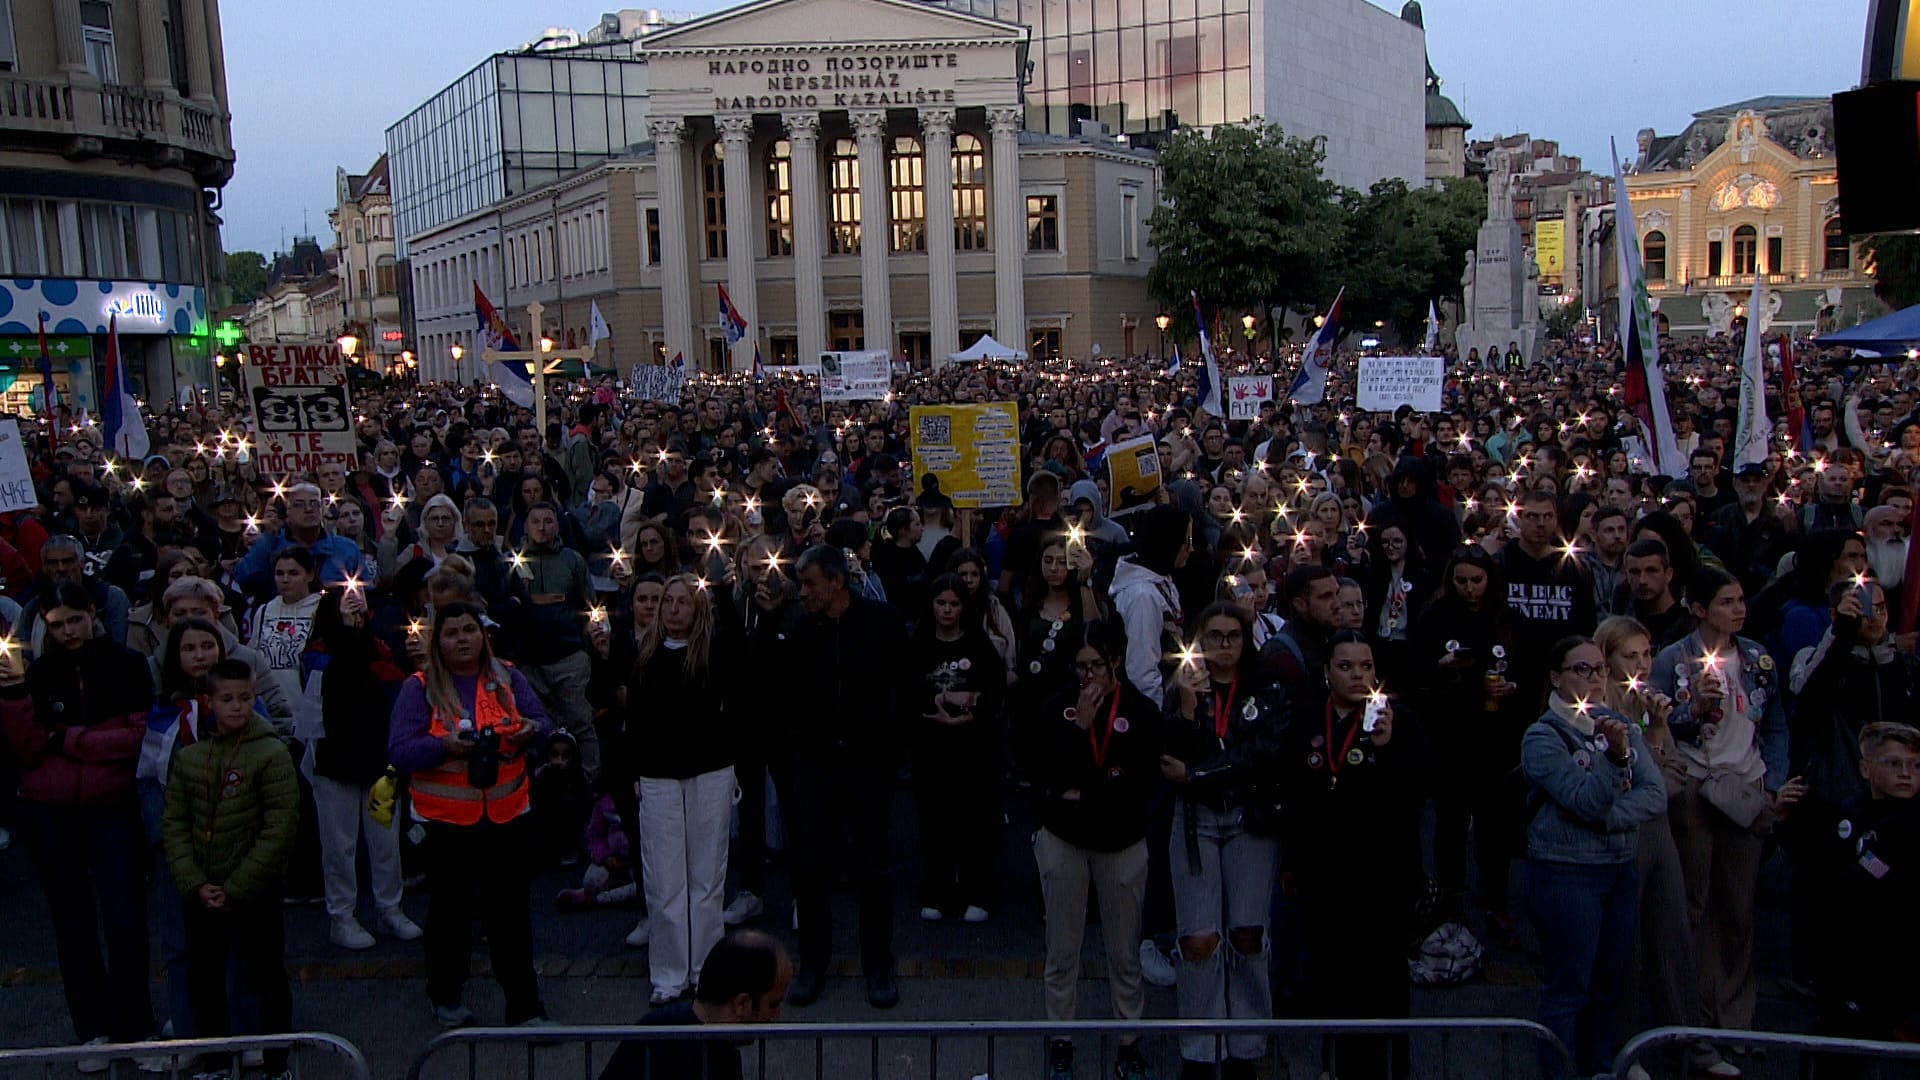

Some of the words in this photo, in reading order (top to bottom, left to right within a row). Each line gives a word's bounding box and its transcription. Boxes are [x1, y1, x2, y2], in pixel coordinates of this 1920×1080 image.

[708, 60, 810, 75] НАРОДНО
[826, 54, 958, 71] ПОЗОРИШТЕ
[767, 72, 900, 91] NÉPSZÍNHÁZ
[715, 95, 818, 110] NARODNO
[834, 87, 955, 107] KAZALIŠTE
[134, 294, 166, 323] lilly
[248, 345, 341, 367] ВЕЛИКИ
[261, 366, 325, 386] БРАТ
[288, 433, 324, 452] ТЕ
[1507, 601, 1572, 621] NEMY
